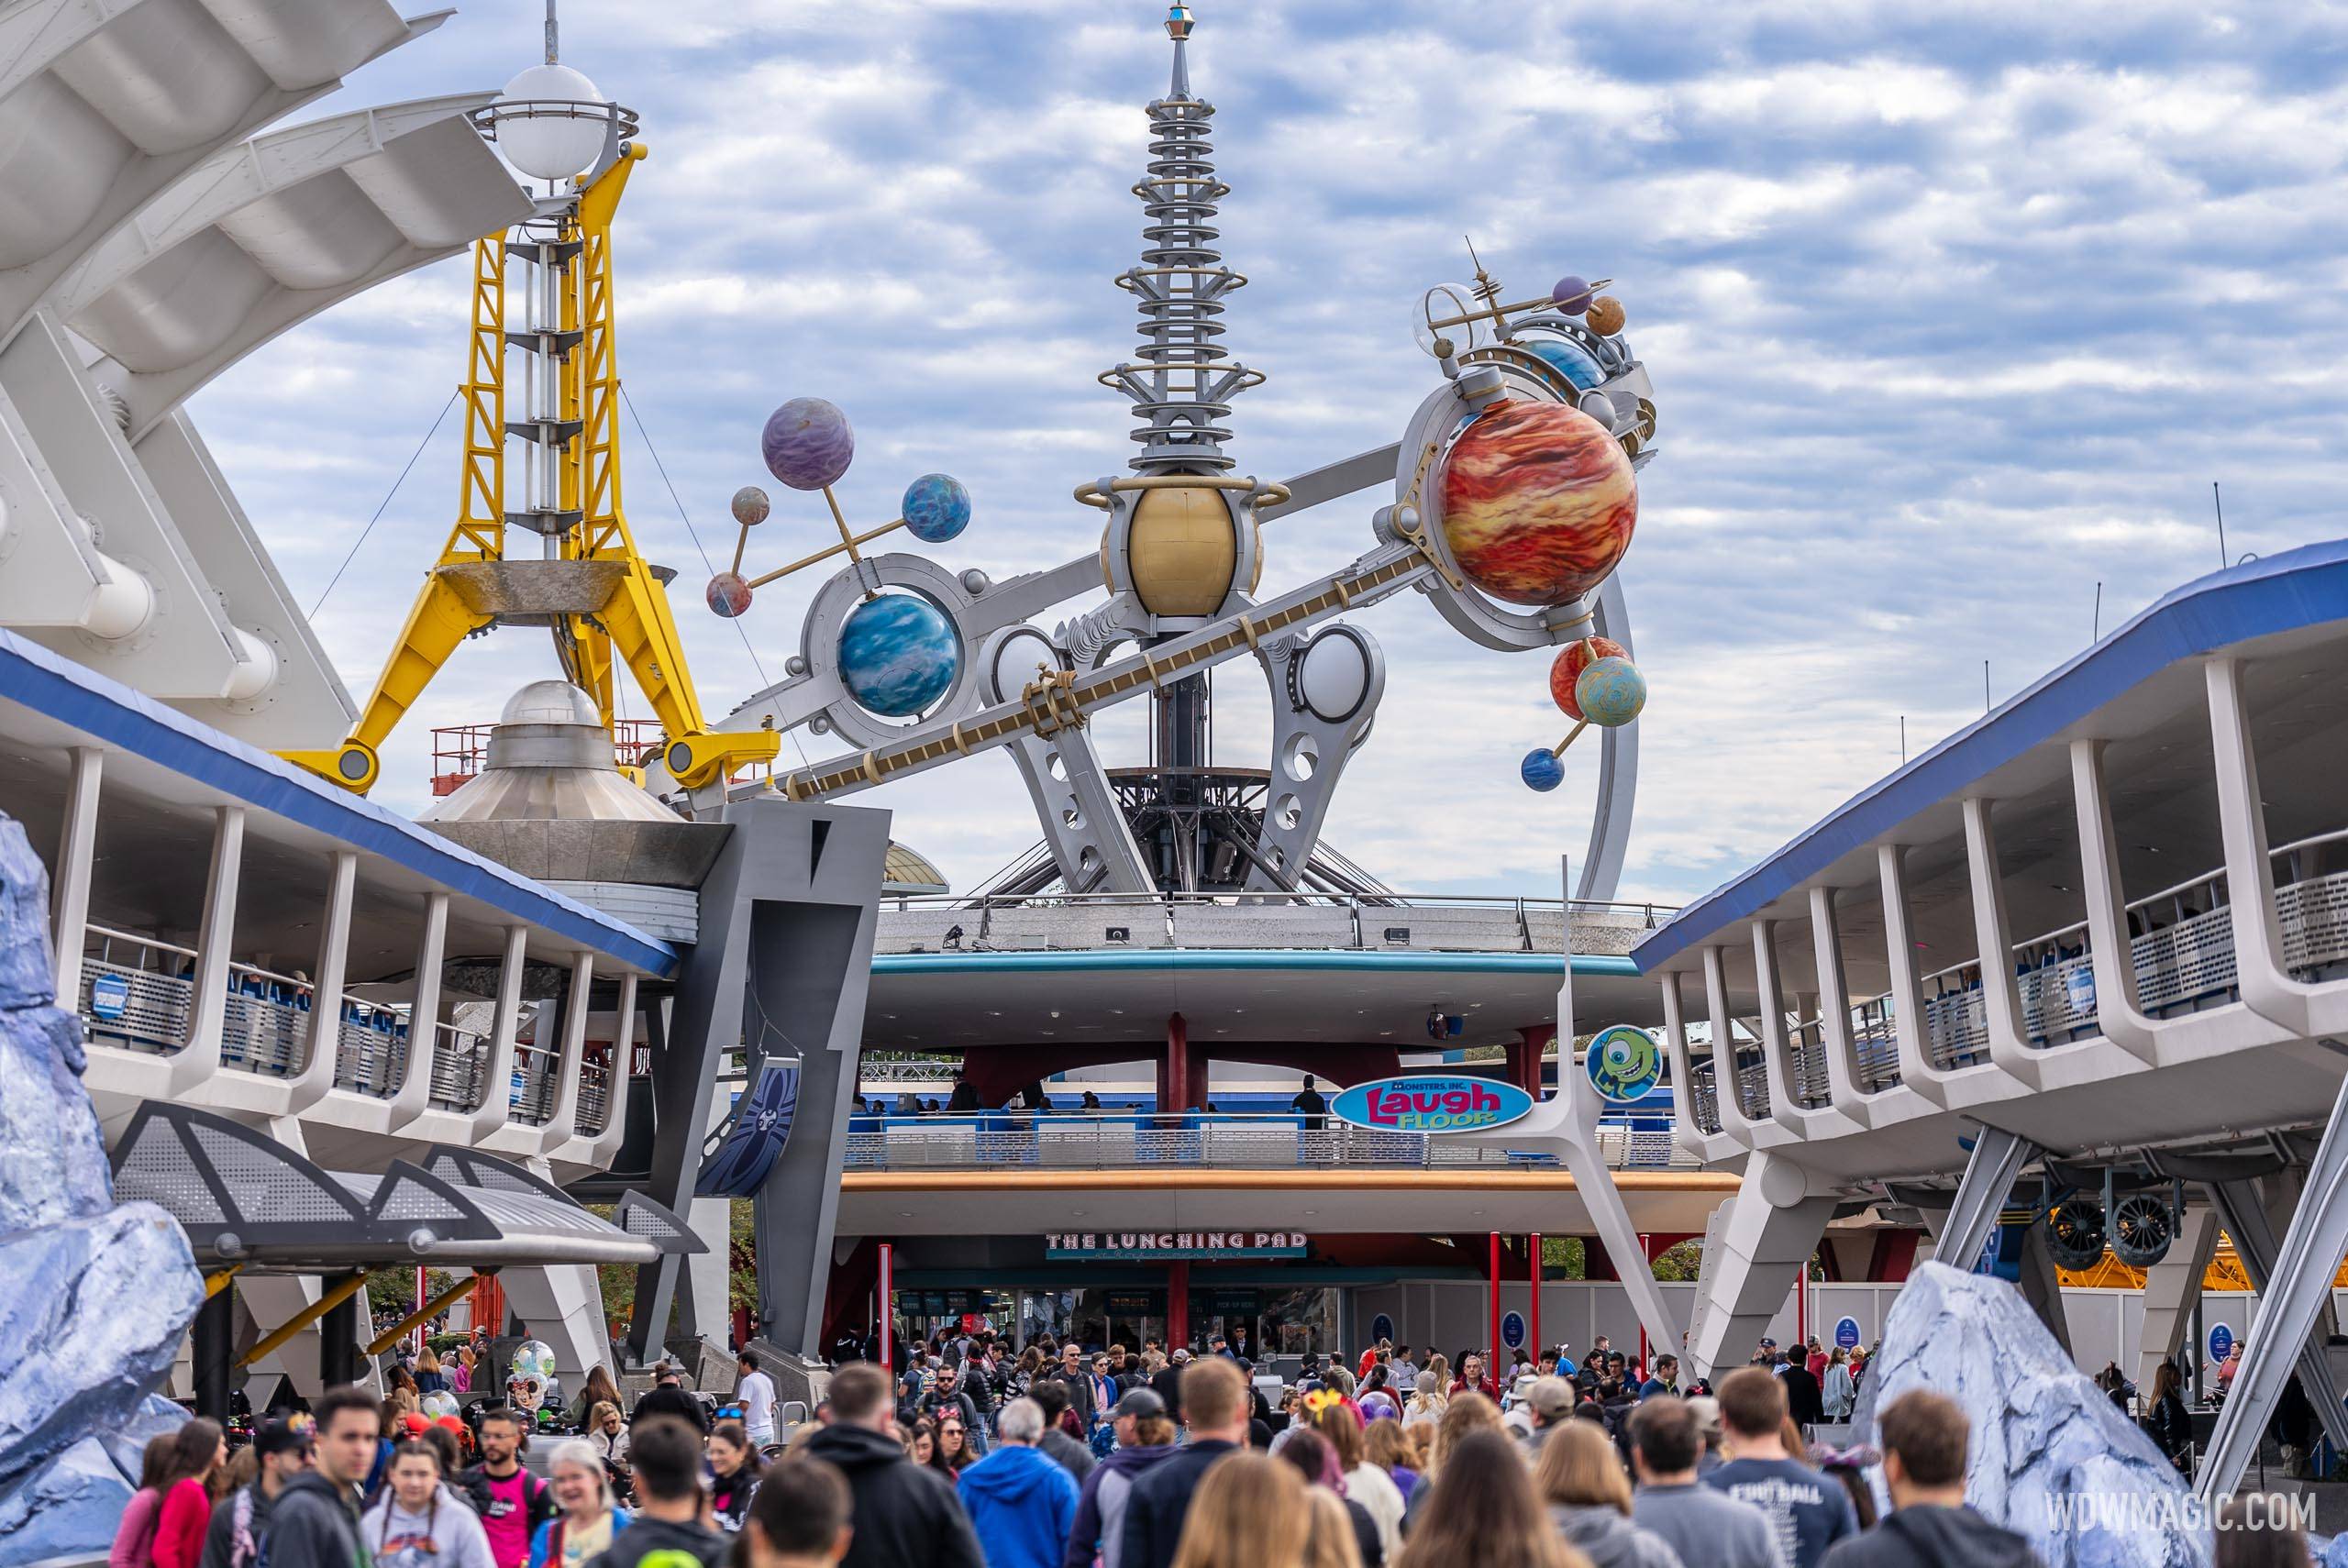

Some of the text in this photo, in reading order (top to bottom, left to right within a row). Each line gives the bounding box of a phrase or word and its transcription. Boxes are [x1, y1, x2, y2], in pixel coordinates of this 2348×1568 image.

[1448, 1082, 1468, 1090] INC.
[1367, 1082, 1501, 1126] Laugh
[1399, 1112, 1499, 1131] FLOOR
[1046, 1232, 1308, 1250] THE LUNCHING PAD
